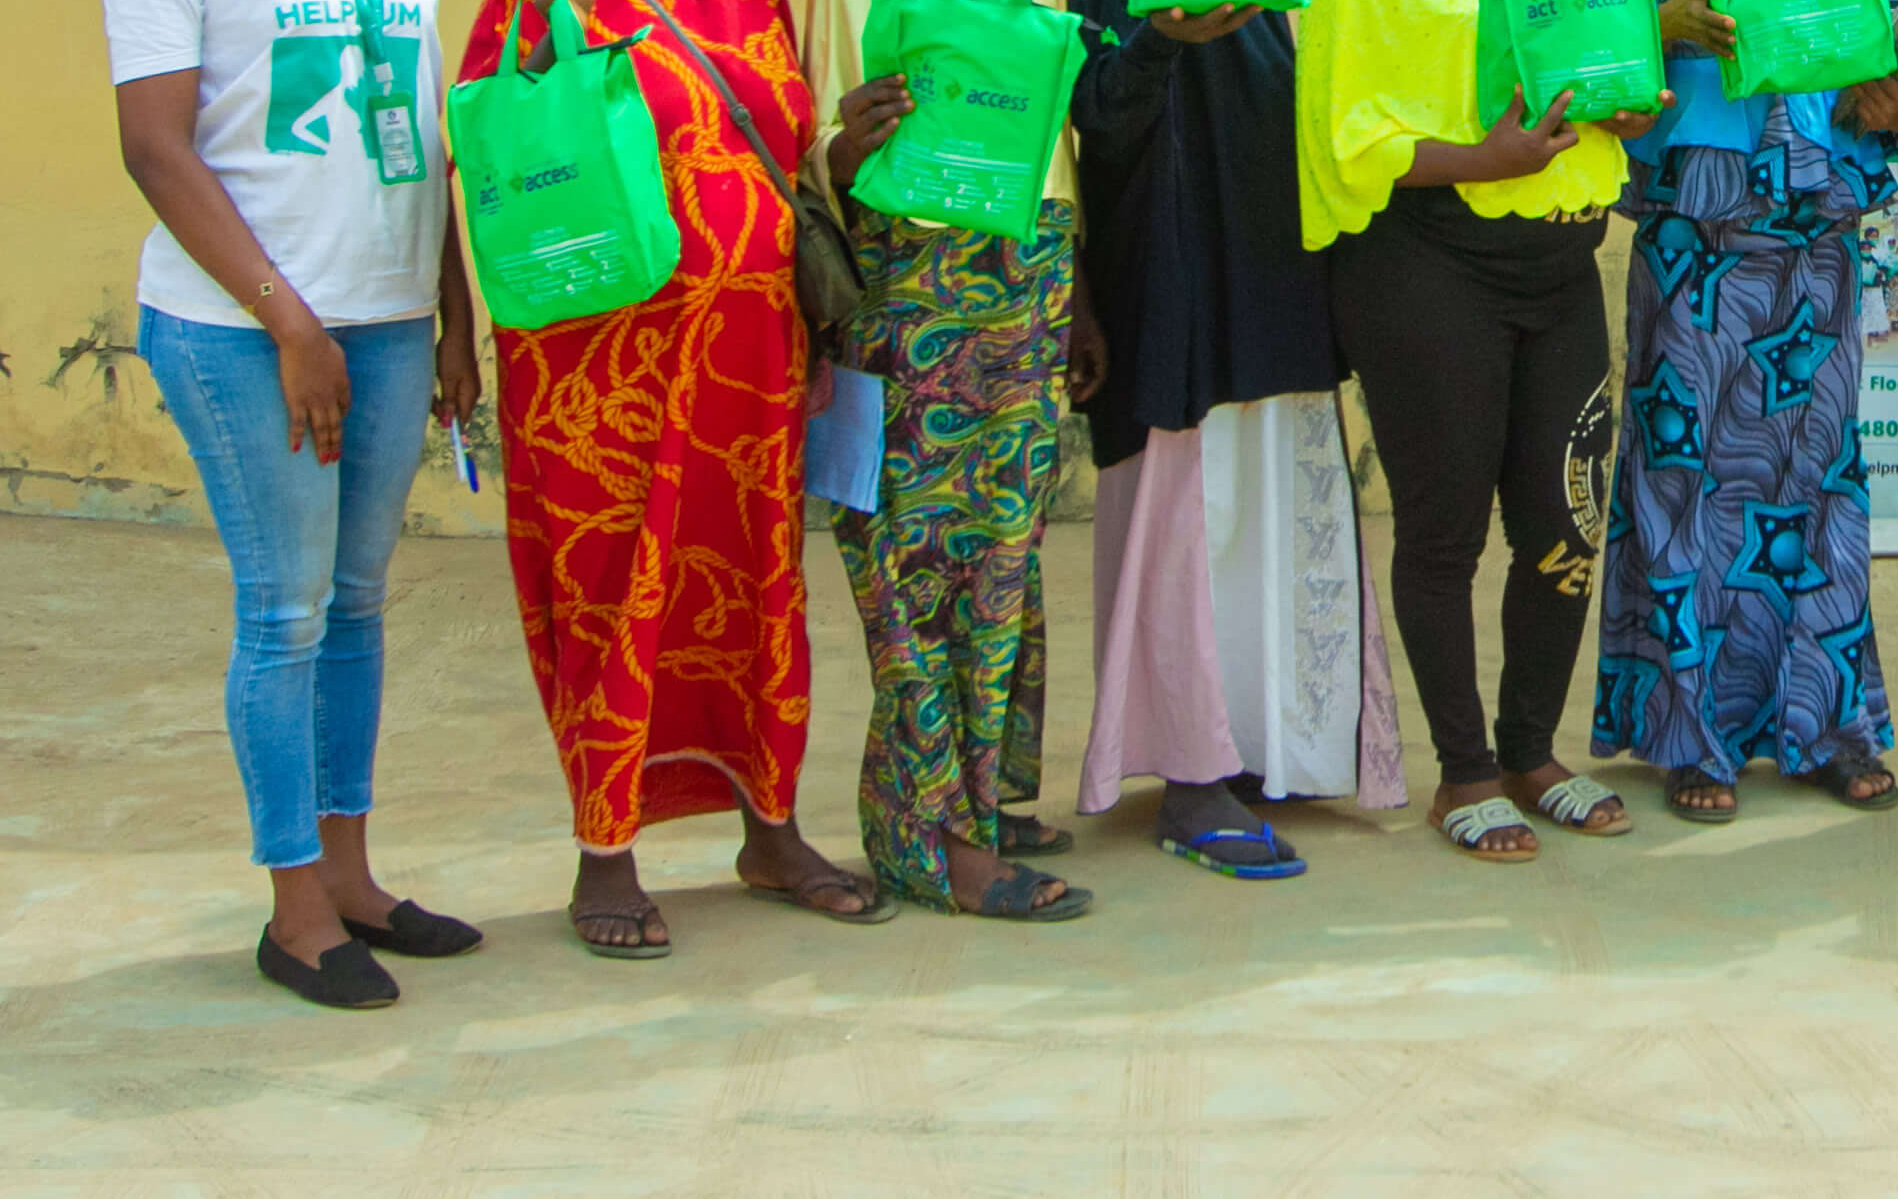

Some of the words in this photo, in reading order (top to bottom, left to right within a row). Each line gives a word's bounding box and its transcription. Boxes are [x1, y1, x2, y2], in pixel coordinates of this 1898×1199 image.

[274, 0, 421, 29] HELPUM
[966, 88, 1030, 113] access
[524, 162, 579, 192] access
